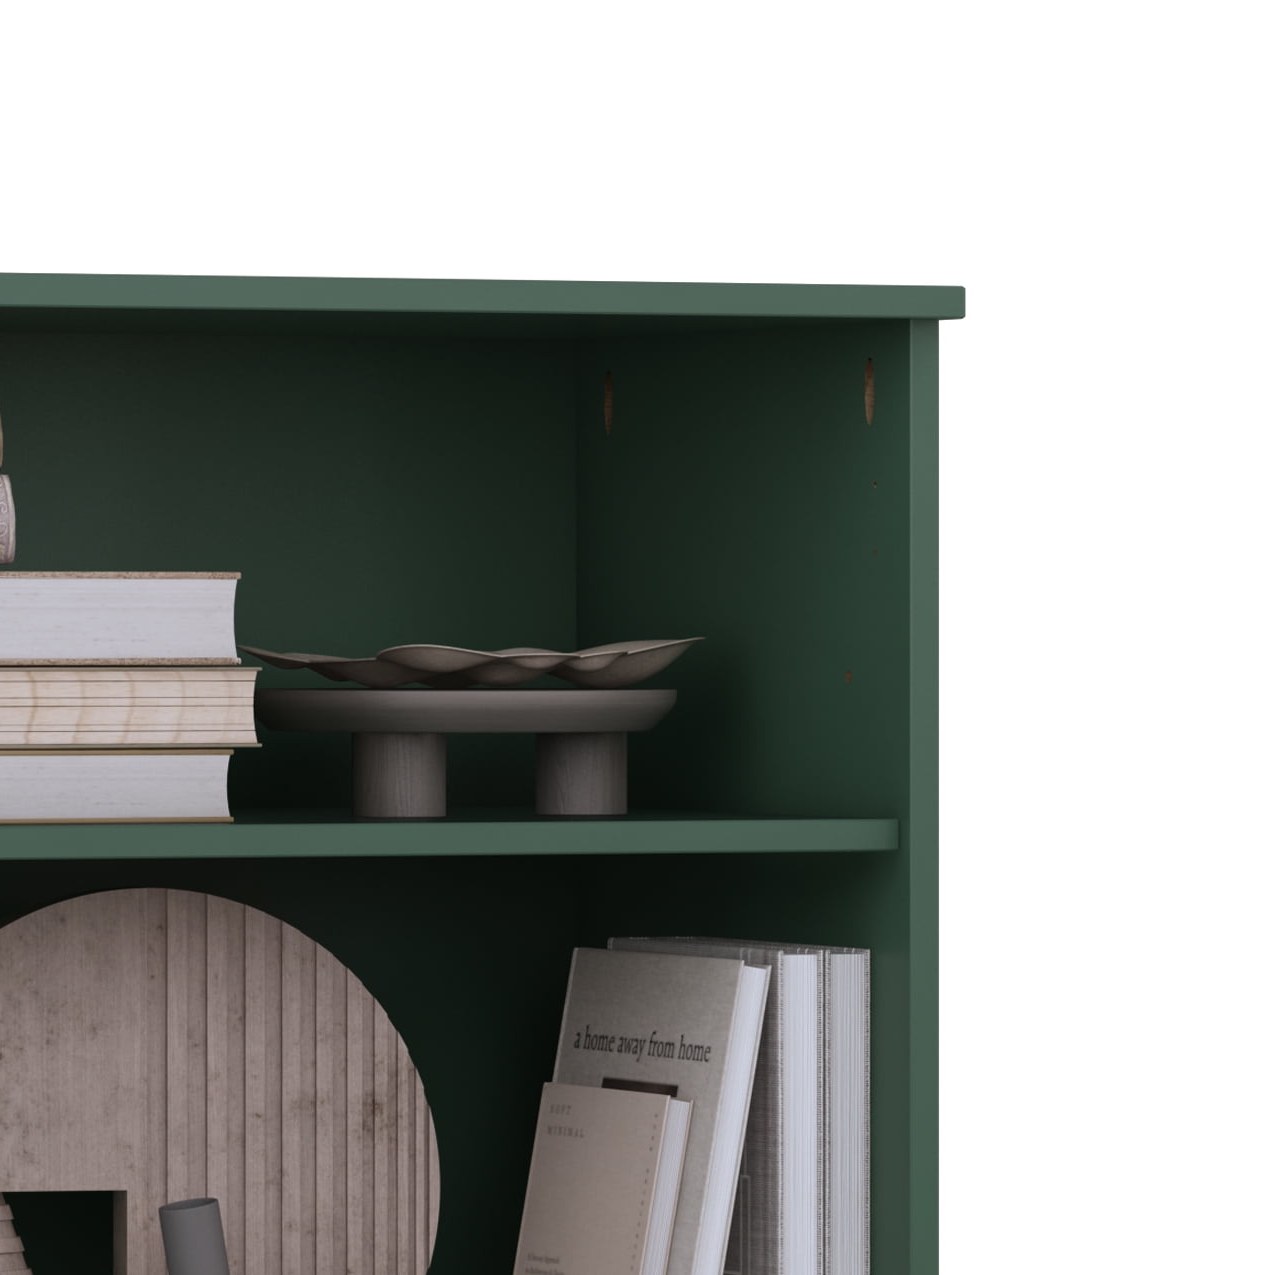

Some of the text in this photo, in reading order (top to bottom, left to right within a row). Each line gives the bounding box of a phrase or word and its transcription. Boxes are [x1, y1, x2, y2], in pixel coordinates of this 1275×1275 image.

[574, 1024, 711, 1062] a home away from home
